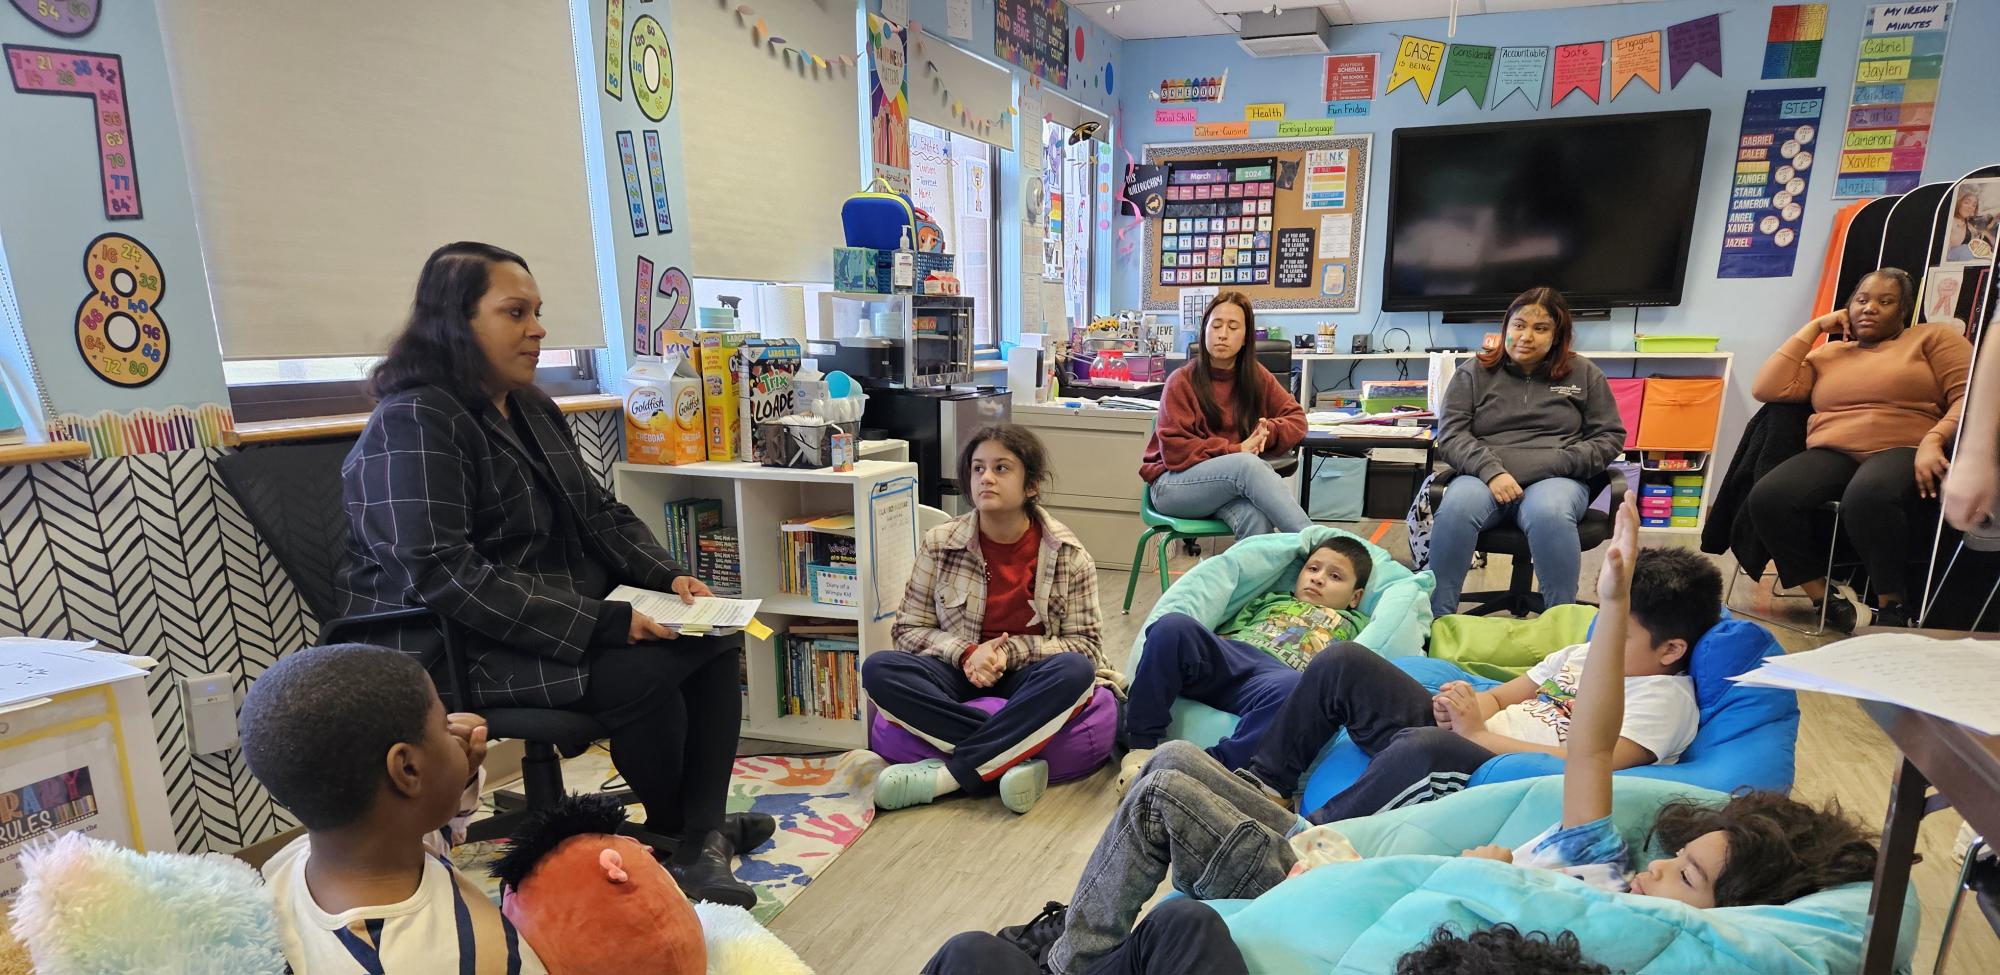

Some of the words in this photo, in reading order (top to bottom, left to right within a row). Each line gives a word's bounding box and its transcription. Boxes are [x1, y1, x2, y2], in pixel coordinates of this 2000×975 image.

[38, 1, 59, 20] 54
[1884, 8, 1901, 16] MY
[1904, 5, 1939, 15] IREADY
[1886, 20, 1932, 31] MINUTES
[1616, 35, 1655, 52] Engaged
[1864, 38, 1906, 53] Gabriel
[1404, 41, 1439, 62] CASE
[1502, 49, 1546, 59] Accountable
[1561, 46, 1590, 59] Safe
[37, 55, 53, 70] 21
[1409, 62, 1431, 71] BEING
[96, 62, 116, 84] 42
[1863, 60, 1902, 81] Jaylen
[1162, 86, 1221, 99] SCHEDUL
[1252, 108, 1282, 118] Health
[1328, 103, 1342, 114] Fun
[1344, 102, 1367, 115] Friday
[1784, 101, 1818, 115] STEP
[105, 132, 124, 146] 63
[1743, 136, 1773, 146] GABRIEL
[1847, 131, 1892, 147] Cameron
[106, 153, 125, 169] 70
[1741, 149, 1767, 159] CALEB
[1846, 154, 1886, 168] Xavier
[1190, 171, 1211, 180] March
[1245, 169, 1262, 178] 2024
[1737, 176, 1767, 185] ZANDER
[111, 174, 129, 191] 77
[1734, 187, 1762, 197] STARLA
[111, 198, 130, 212] 84
[1733, 199, 1771, 209] CAMERON
[659, 213, 668, 225] 132
[1729, 213, 1753, 222] ANGEL
[1727, 223, 1754, 233] XAVIER
[1725, 238, 1751, 248] JAZIEL
[101, 244, 118, 263] 16
[122, 243, 141, 262] 24
[95, 264, 104, 280] 8
[1241, 271, 1249, 279] 29
[139, 273, 157, 291] 32
[100, 291, 119, 309] 48
[128, 298, 149, 313] 40
[142, 324, 160, 340] 96
[85, 335, 105, 352] 64
[638, 339, 646, 350] 72
[103, 357, 121, 374] 72
[129, 361, 148, 377] 80
[761, 370, 789, 392] Trix
[632, 397, 664, 415] Goldfish
[755, 390, 794, 422] LOADE
[636, 432, 665, 442] CHEDDAR
